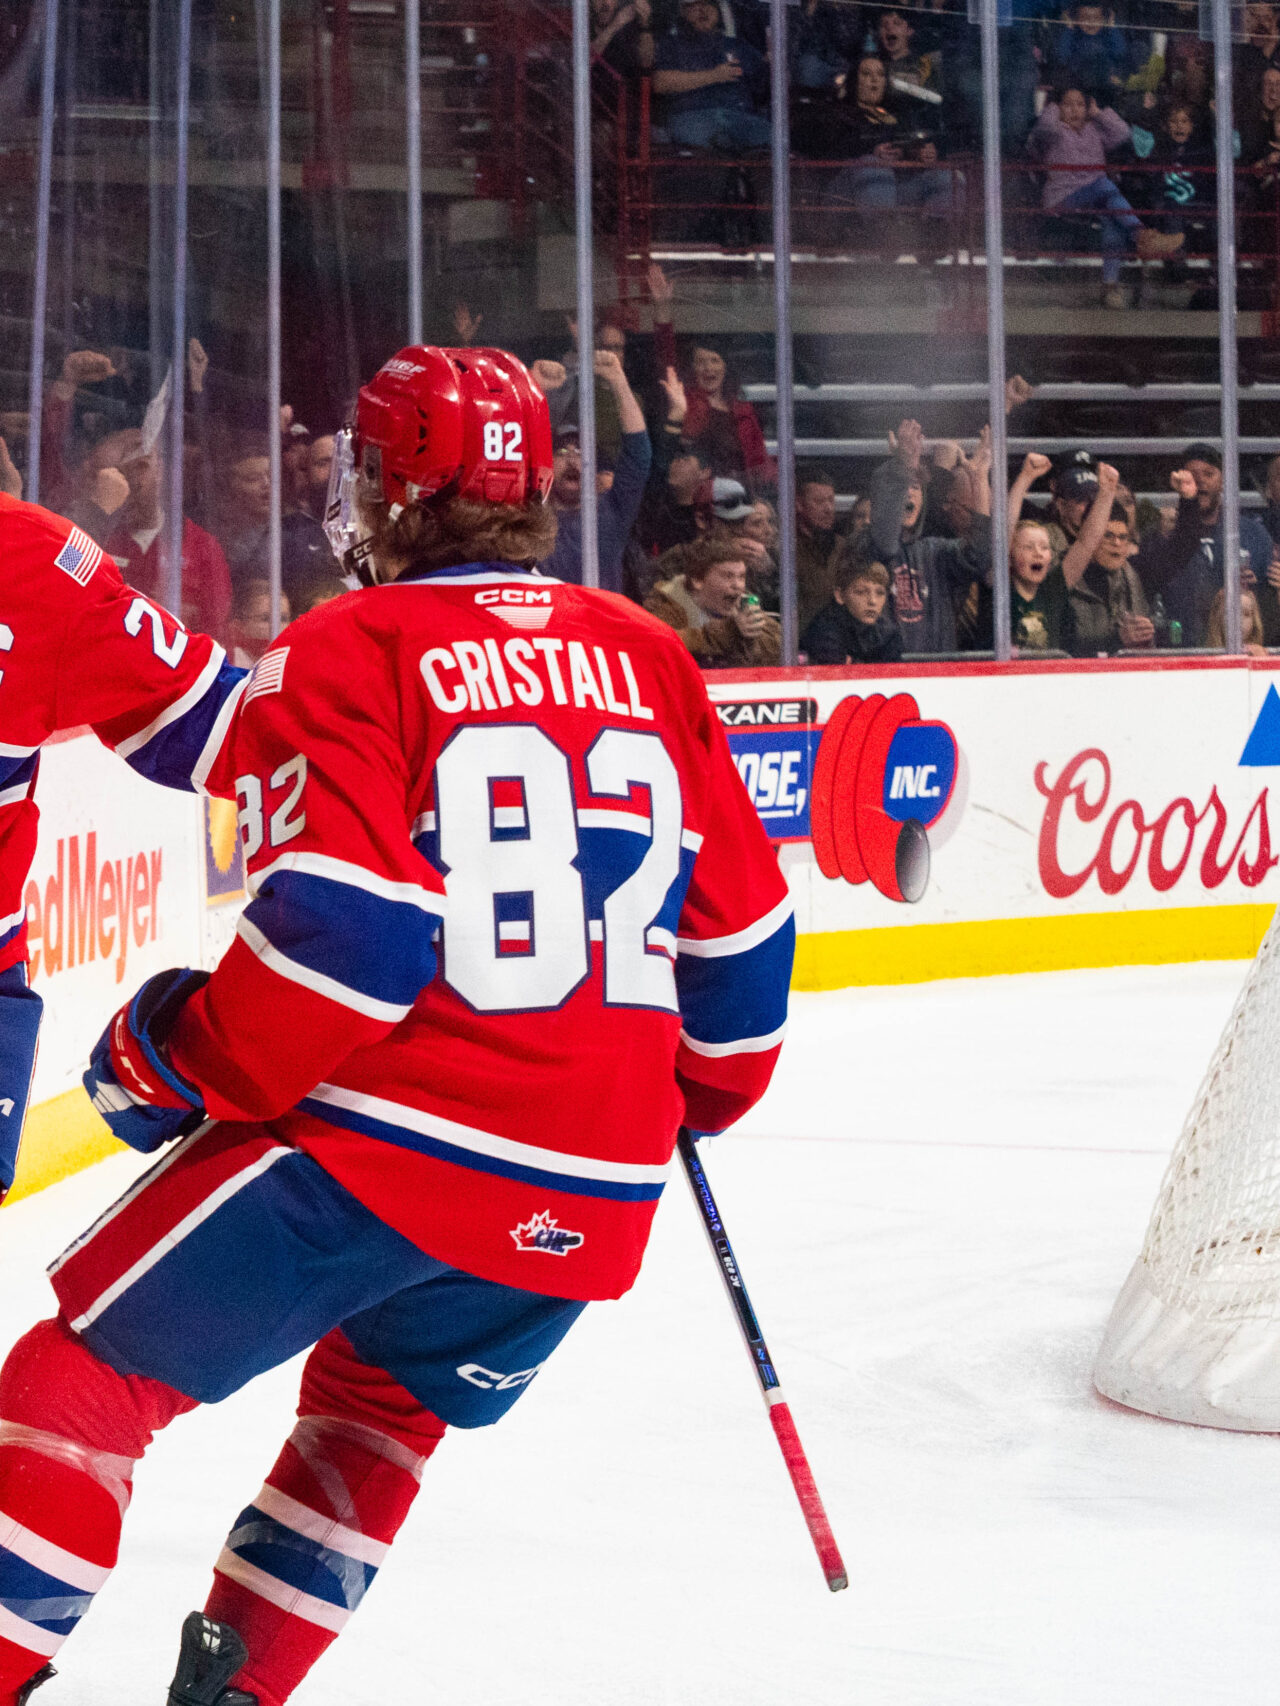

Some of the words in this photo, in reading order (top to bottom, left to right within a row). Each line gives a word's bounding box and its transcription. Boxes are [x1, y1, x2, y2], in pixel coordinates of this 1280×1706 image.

[483, 422, 523, 462] 82
[123, 590, 190, 670] 2
[473, 589, 552, 605] CCM
[419, 638, 654, 721] CRISTALL
[731, 750, 807, 817] OSE,
[889, 764, 941, 801] INC.
[1034, 747, 1280, 899] Coors
[433, 723, 683, 1014] 82
